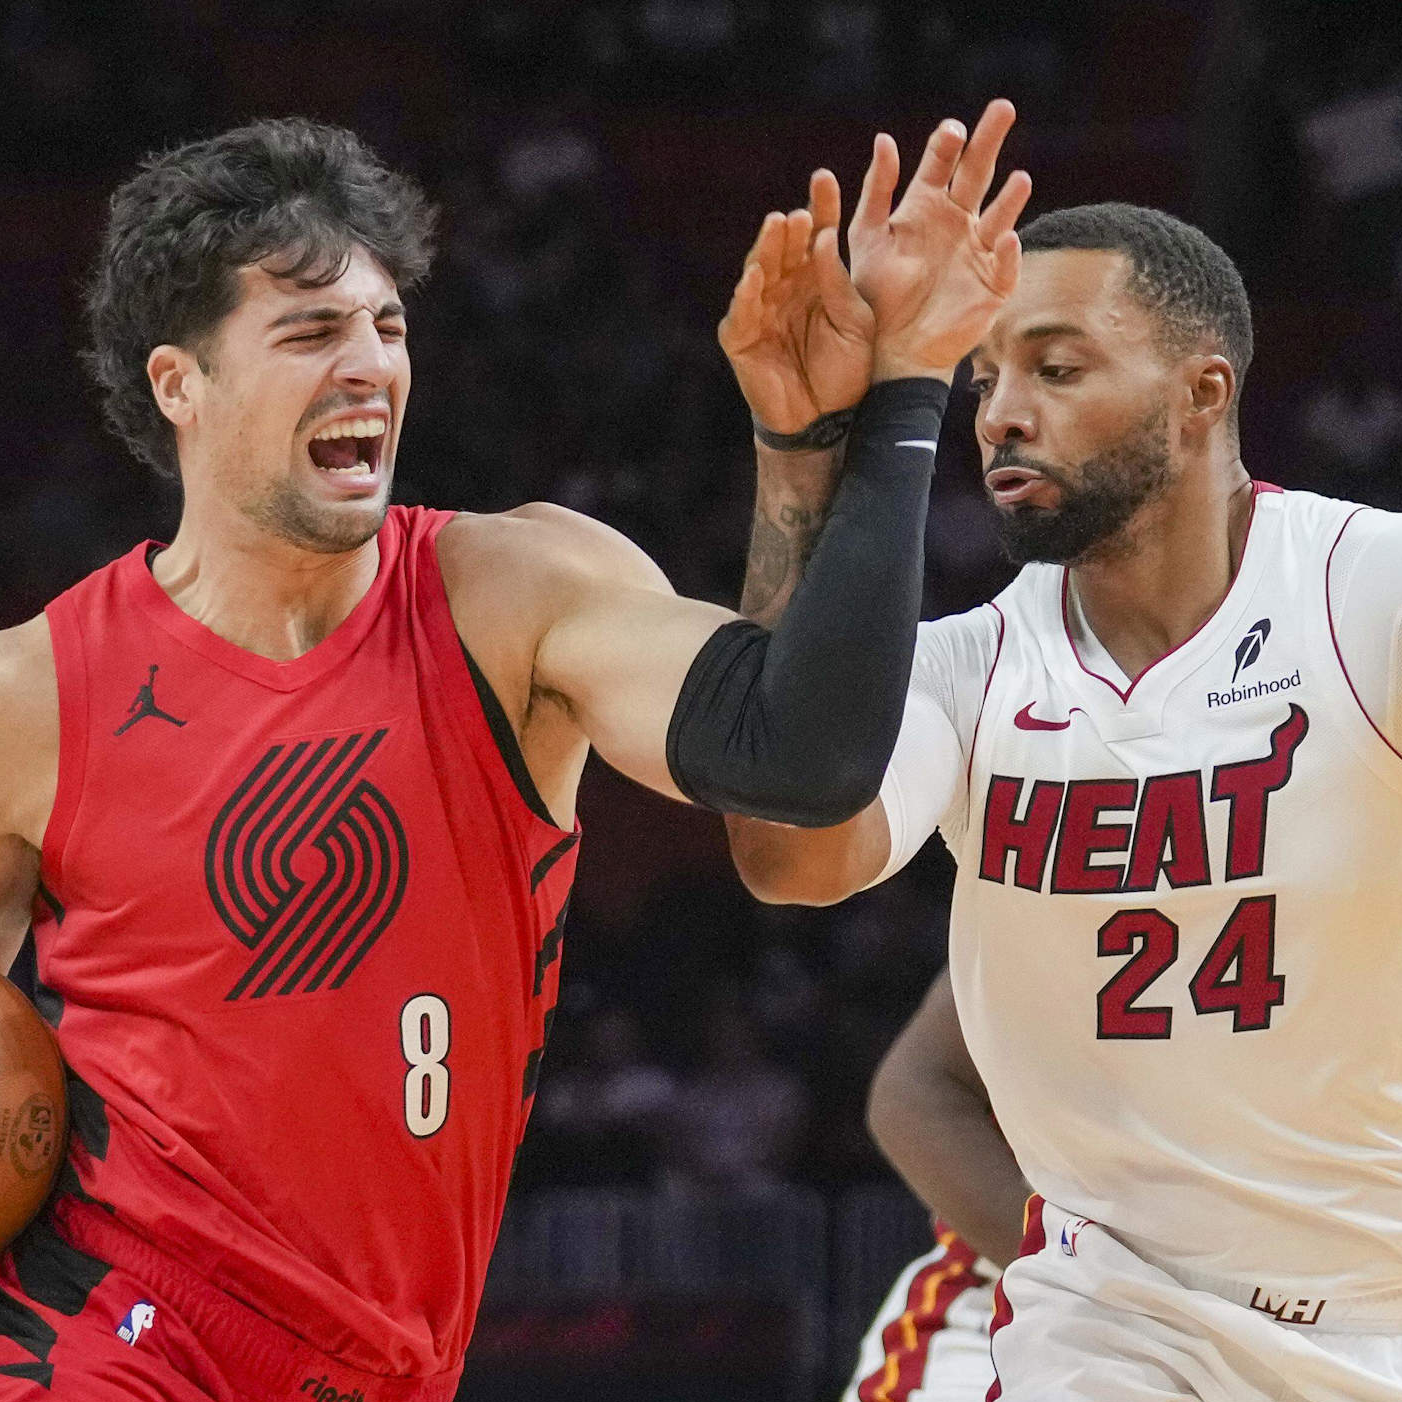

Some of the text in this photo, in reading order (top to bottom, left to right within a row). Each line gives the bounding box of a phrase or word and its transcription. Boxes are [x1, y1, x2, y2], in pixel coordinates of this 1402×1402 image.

[1207, 668, 1302, 708] Robinhood
[978, 702, 1309, 895] HEAT
[1097, 894, 1285, 1040] 24
[399, 991, 451, 1139] 8
